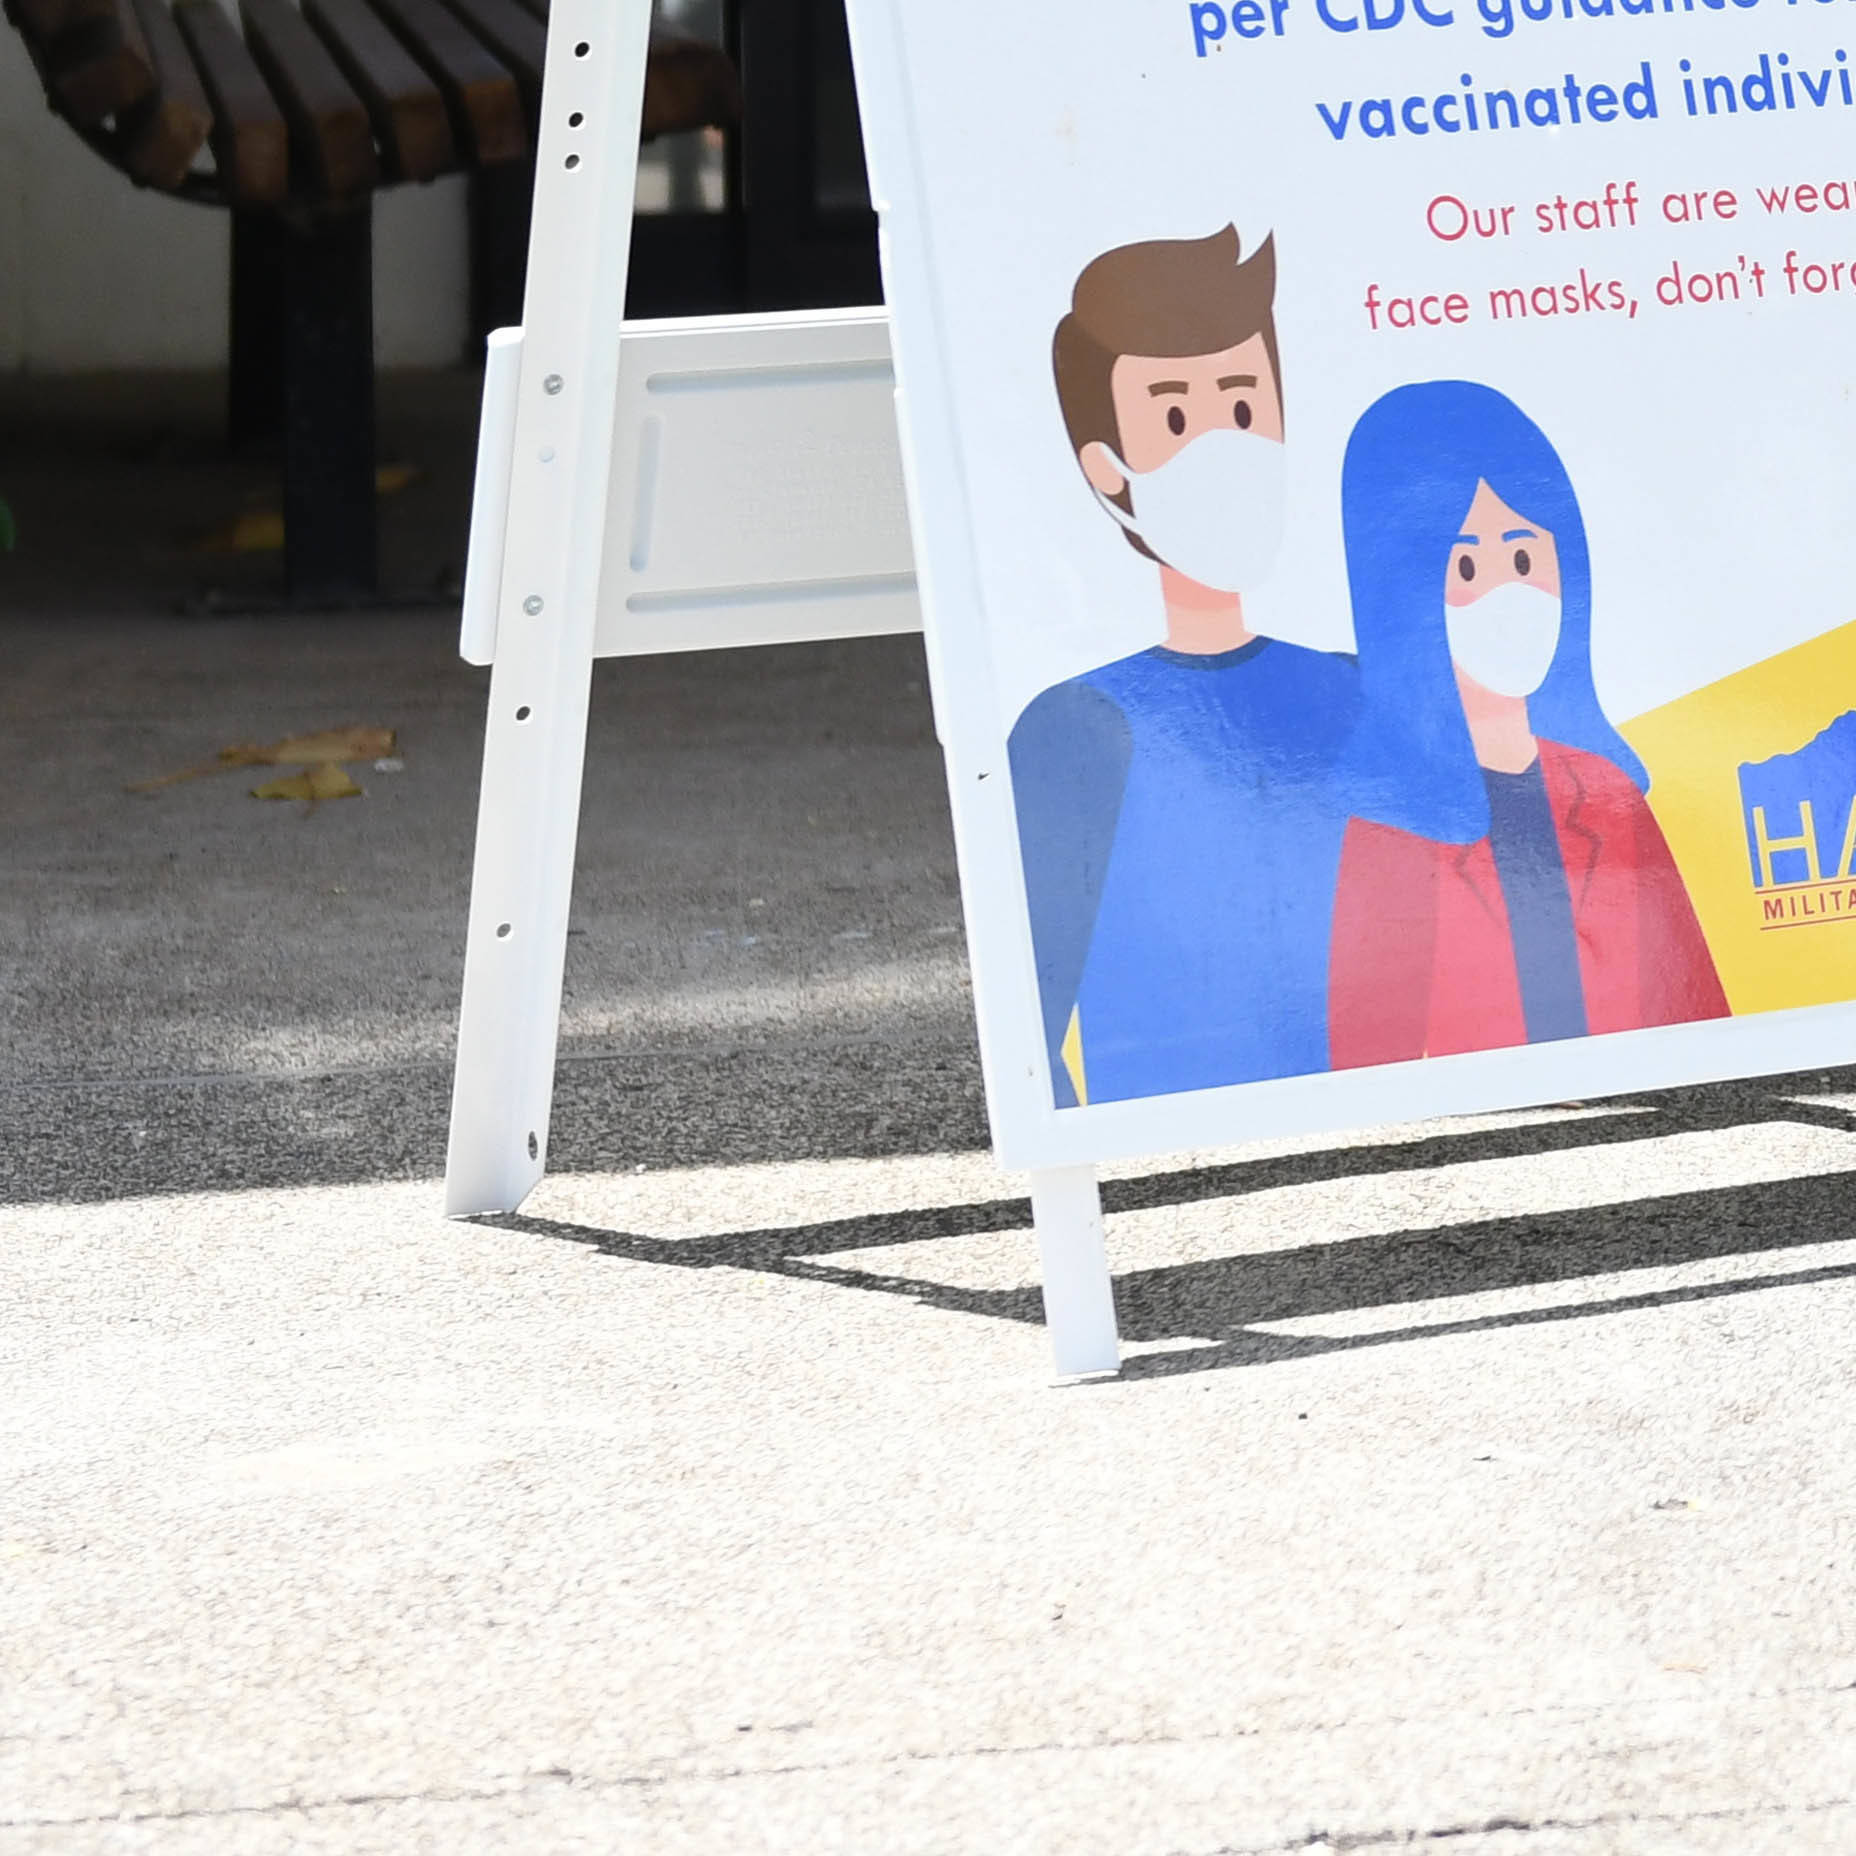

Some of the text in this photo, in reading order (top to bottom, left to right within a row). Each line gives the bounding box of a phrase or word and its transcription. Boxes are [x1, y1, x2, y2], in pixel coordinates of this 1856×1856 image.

[1189, 0, 1289, 57] per
[1317, 62, 1658, 140] vaccinated
[1427, 196, 1514, 240] Our
[1536, 182, 1638, 232] staff
[1663, 191, 1737, 222] are
[1366, 285, 1469, 328] face
[1490, 269, 1638, 318] masks,
[1657, 256, 1765, 305] don't
